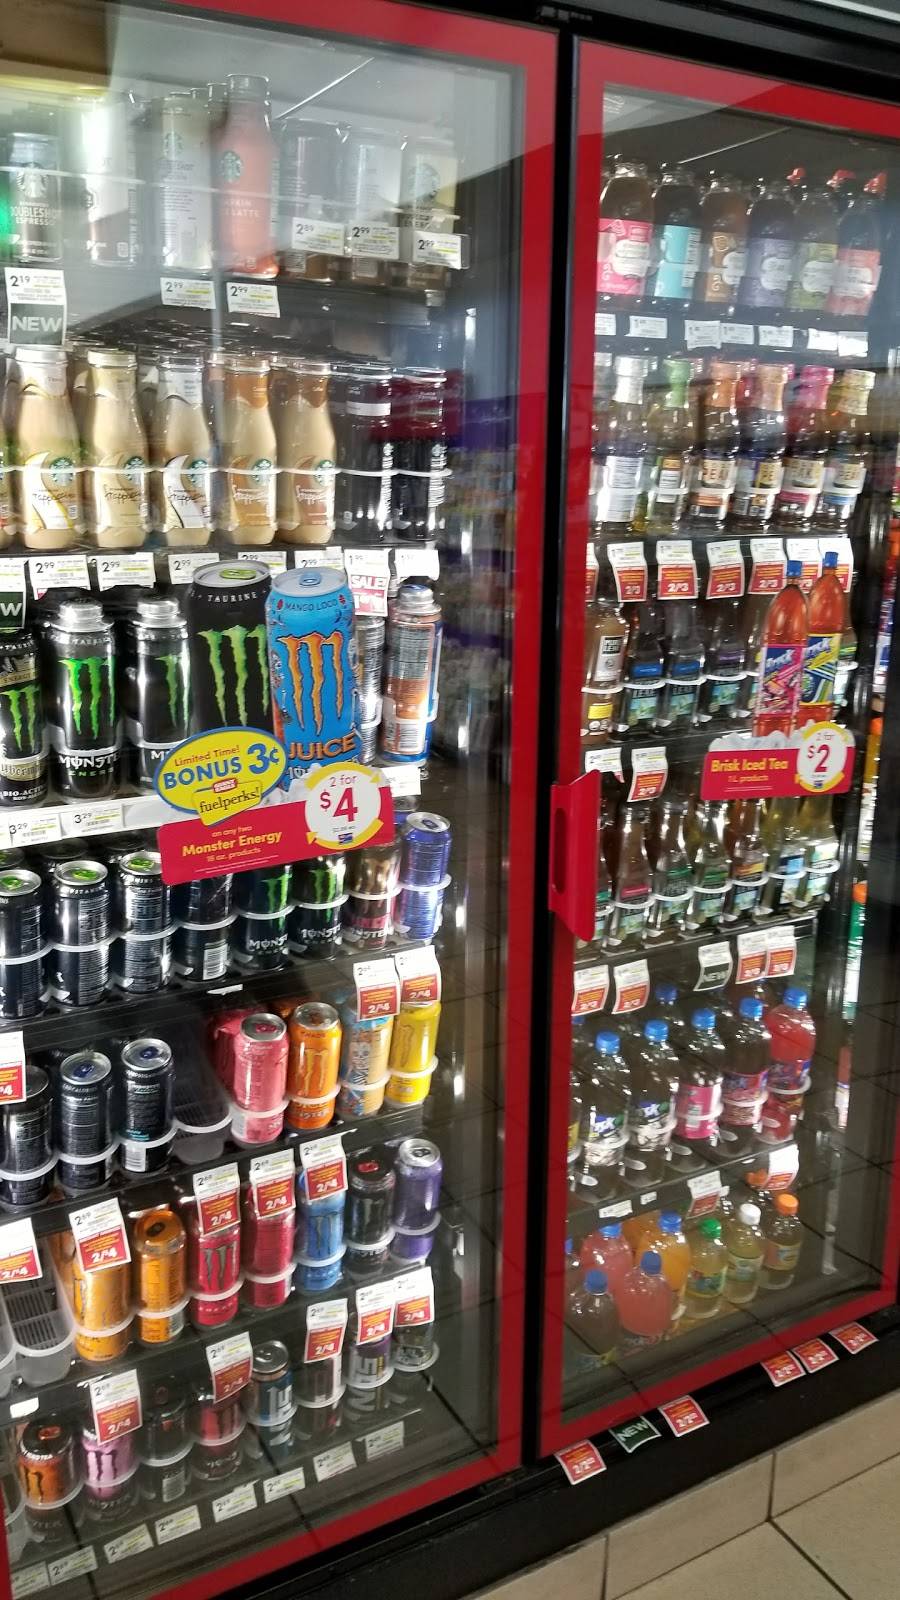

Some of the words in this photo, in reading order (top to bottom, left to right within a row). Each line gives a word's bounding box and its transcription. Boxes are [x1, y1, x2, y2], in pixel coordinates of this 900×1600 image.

[12, 317, 62, 332] NEW
[350, 575, 387, 588] SALE
[208, 591, 257, 602] TAURINE
[286, 602, 315, 612] MANGO
[288, 731, 357, 761] JUICE
[174, 752, 211, 767] Limited
[214, 745, 240, 759] Time!
[711, 759, 740, 773] Brisk
[742, 758, 767, 771] Iced
[769, 757, 789, 770] Tea
[807, 744, 831, 773] $2
[163, 757, 242, 790] BONUS
[247, 743, 280, 775] 3¢
[330, 776, 337, 788] 2
[340, 774, 357, 785] for
[199, 786, 260, 814] fuelperks!
[320, 787, 359, 823] $4
[211, 830, 222, 838] on
[222, 828, 237, 838] any
[237, 825, 253, 834] two
[182, 837, 236, 857] Monster
[239, 831, 283, 848] Energy
[228, 847, 262, 860] products
[617, 1420, 650, 1442] NEW
